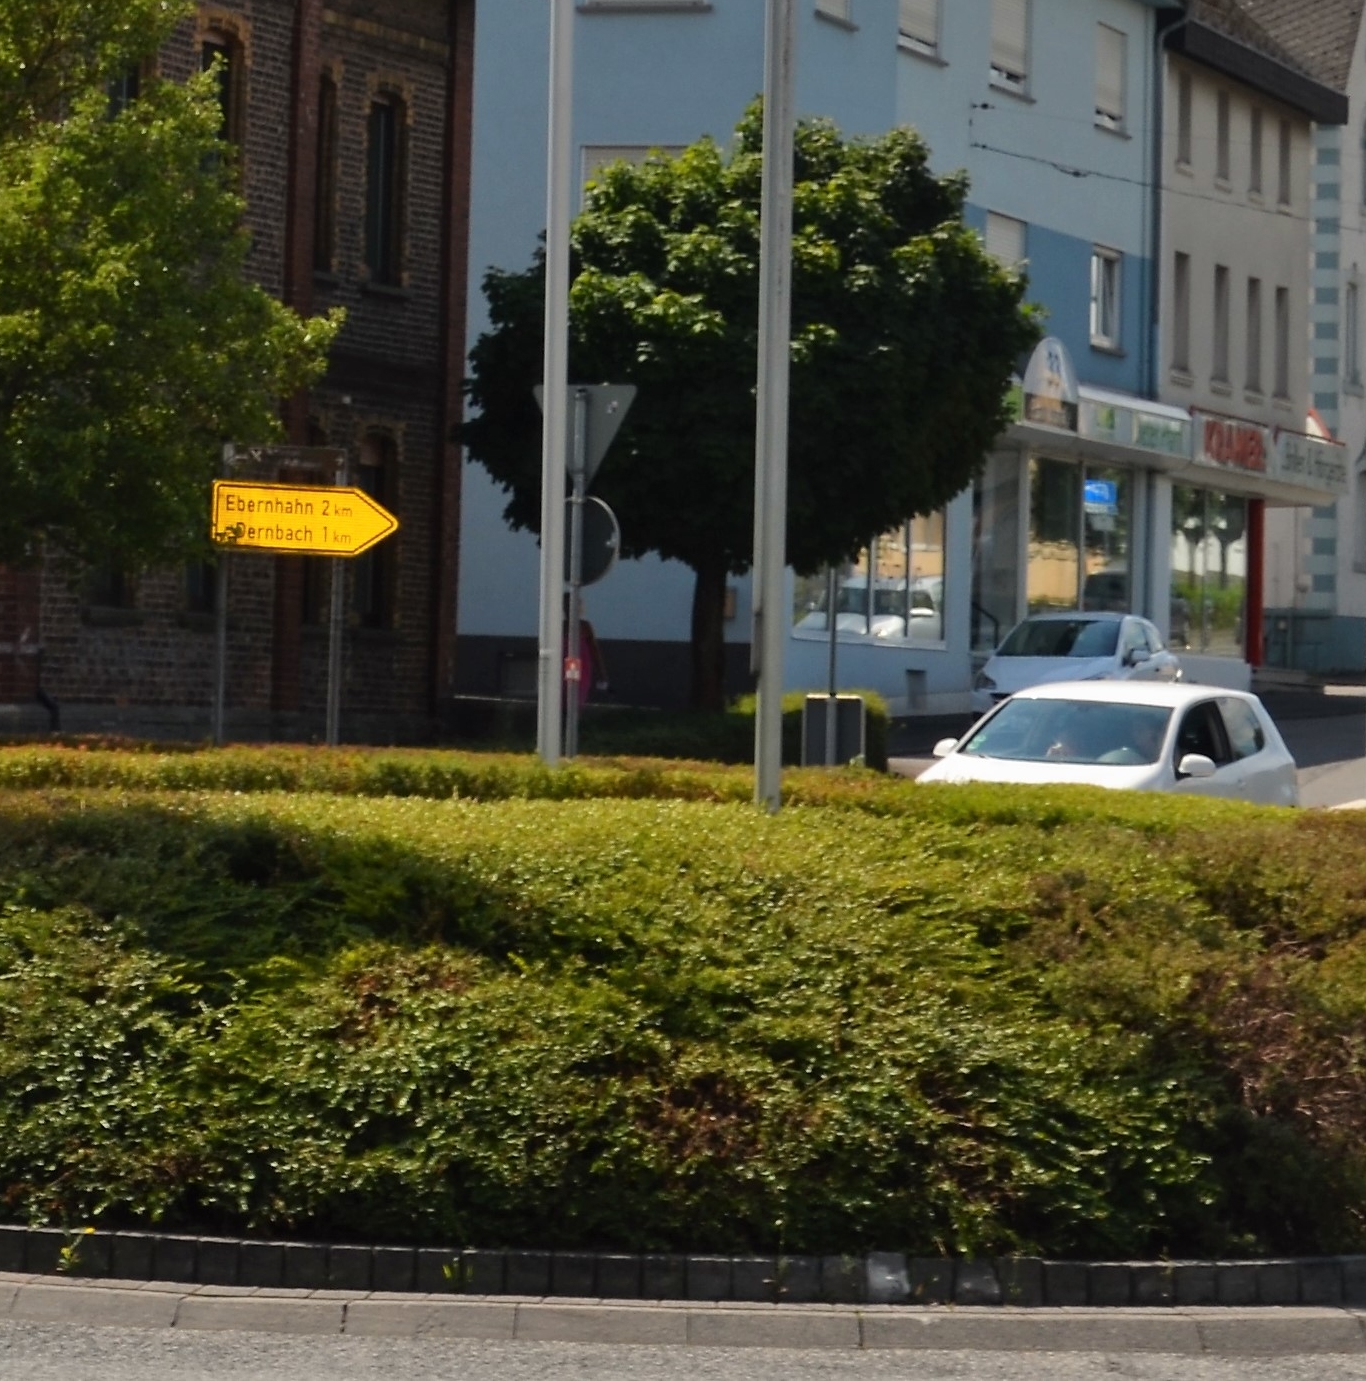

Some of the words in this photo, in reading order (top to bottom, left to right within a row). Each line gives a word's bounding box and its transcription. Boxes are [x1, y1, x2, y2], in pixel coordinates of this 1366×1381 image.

[225, 494, 314, 515] Ebernhahn
[322, 500, 330, 516] 2
[335, 504, 353, 517] km
[235, 521, 313, 541] Dernbach
[335, 530, 352, 544] km
